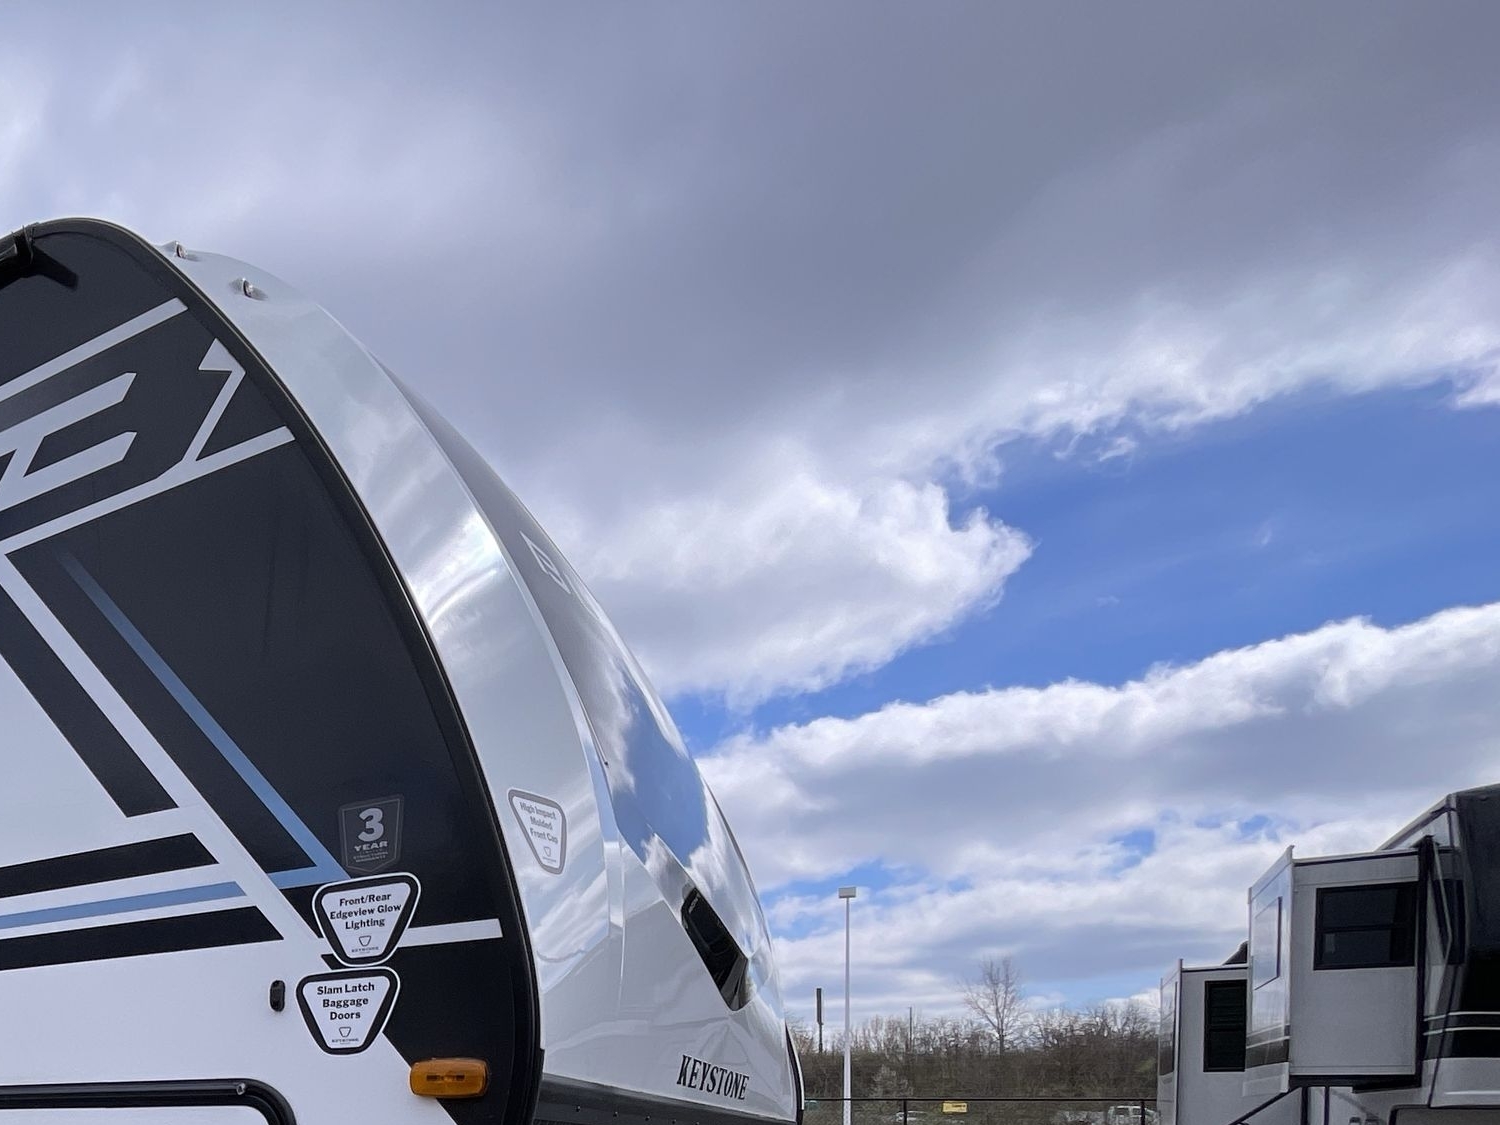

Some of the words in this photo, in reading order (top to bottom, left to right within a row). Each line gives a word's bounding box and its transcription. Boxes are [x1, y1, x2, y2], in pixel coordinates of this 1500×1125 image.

[358, 807, 384, 842] 3
[529, 827, 546, 840] Front
[354, 840, 388, 852] YEAR
[339, 894, 392, 907] Front/Rear
[330, 907, 376, 920] Edgeview
[377, 904, 402, 914] Glow
[345, 918, 386, 930] Lighting
[317, 985, 342, 995] Slam
[345, 982, 375, 993] Latch
[322, 997, 369, 1009] Baggage
[330, 1011, 361, 1020] Doors
[676, 1054, 750, 1100] KEYSTONE
